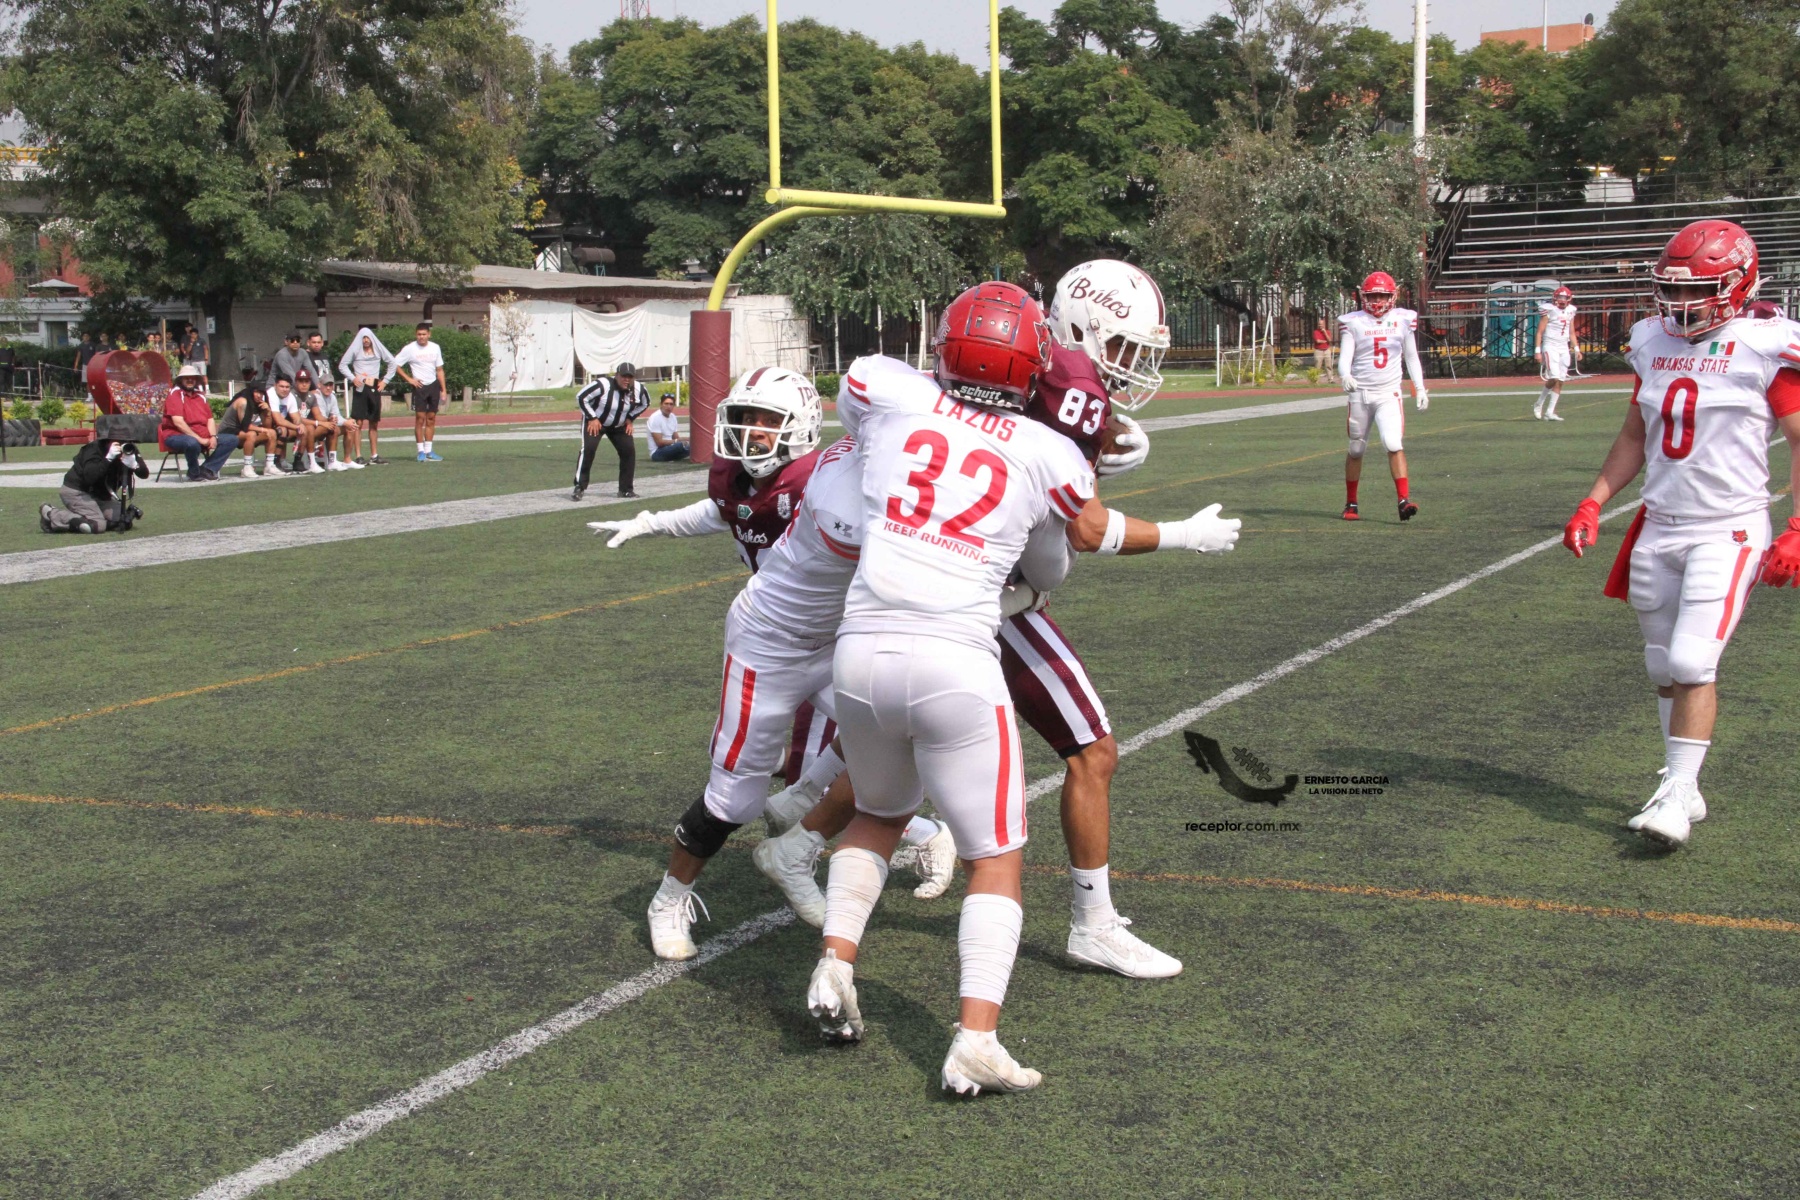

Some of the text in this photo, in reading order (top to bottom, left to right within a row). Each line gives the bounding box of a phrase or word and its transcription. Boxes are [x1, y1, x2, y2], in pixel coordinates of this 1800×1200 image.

[1373, 336, 1388, 370] 5
[1650, 356, 1730, 374] ARKANSAS STATE
[959, 385, 1002, 400] schutt
[1058, 387, 1105, 435] 83
[932, 390, 1017, 442] LAZOS
[1661, 377, 1699, 459] 0
[886, 429, 1008, 549] 32
[883, 520, 990, 565] KEEP RUNNING
